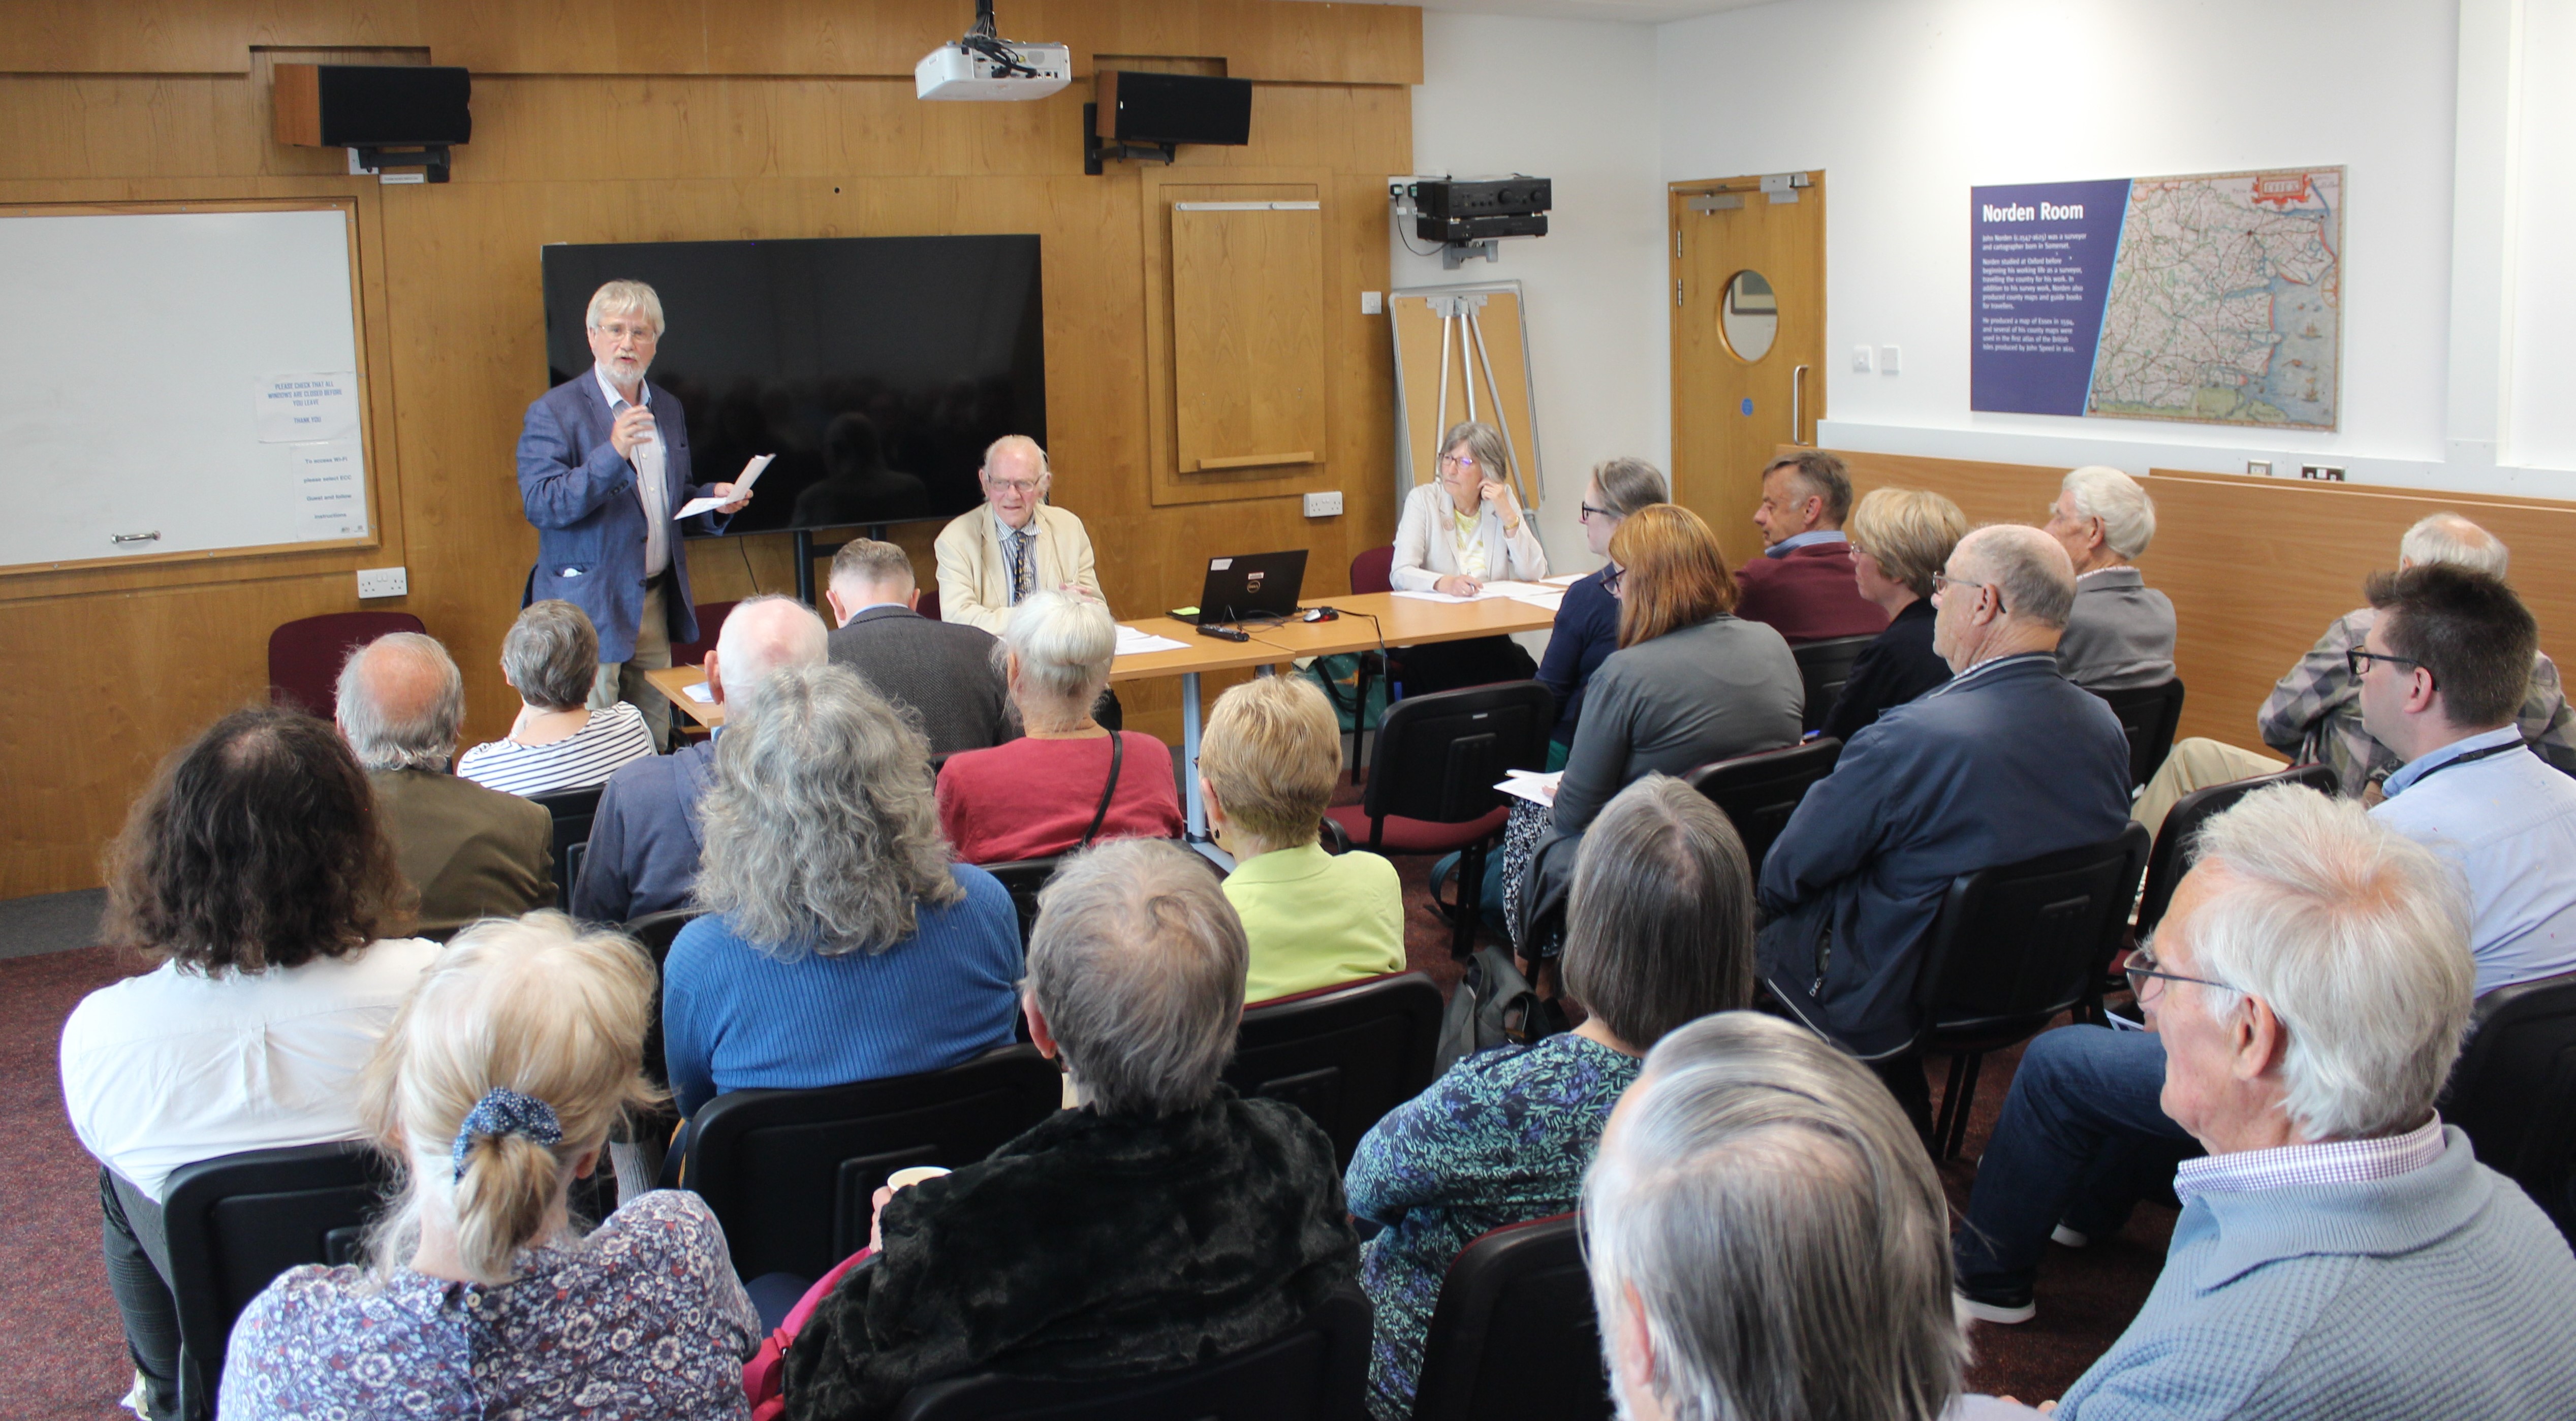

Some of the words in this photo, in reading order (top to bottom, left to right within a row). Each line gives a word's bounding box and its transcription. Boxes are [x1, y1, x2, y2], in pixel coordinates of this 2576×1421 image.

[1983, 203, 2034, 222] Norden
[2040, 202, 2083, 220] Room
[1993, 243, 2024, 251] cartographer
[1983, 276, 2005, 284] travelling
[1991, 317, 2013, 325] produced
